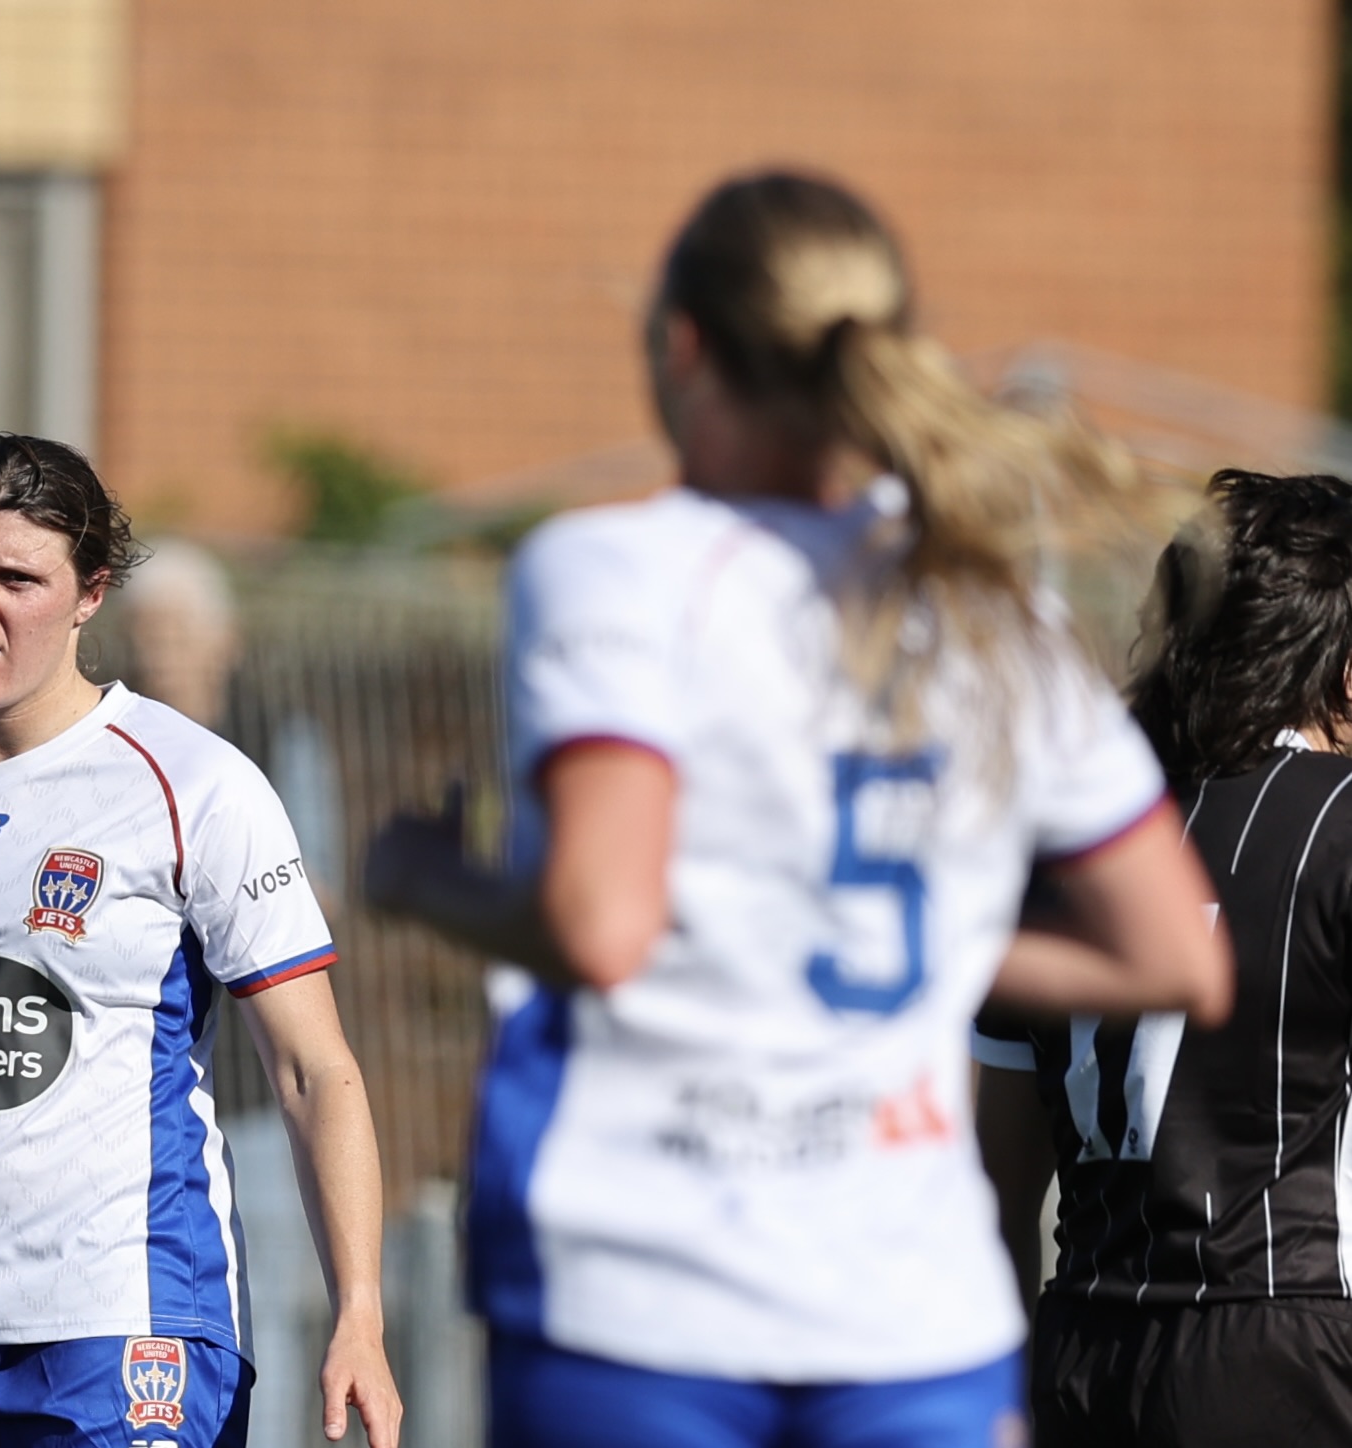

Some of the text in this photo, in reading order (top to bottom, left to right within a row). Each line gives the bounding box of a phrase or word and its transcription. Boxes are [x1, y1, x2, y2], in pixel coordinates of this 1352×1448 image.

[54, 854, 96, 869] NEWCASTLE
[59, 861, 86, 872] UNITED
[804, 747, 945, 1018] 5
[37, 911, 76, 931] JETS
[137, 1342, 176, 1353] NEWCASTLE
[143, 1350, 168, 1359] UNITED
[139, 1404, 174, 1419] JETS
